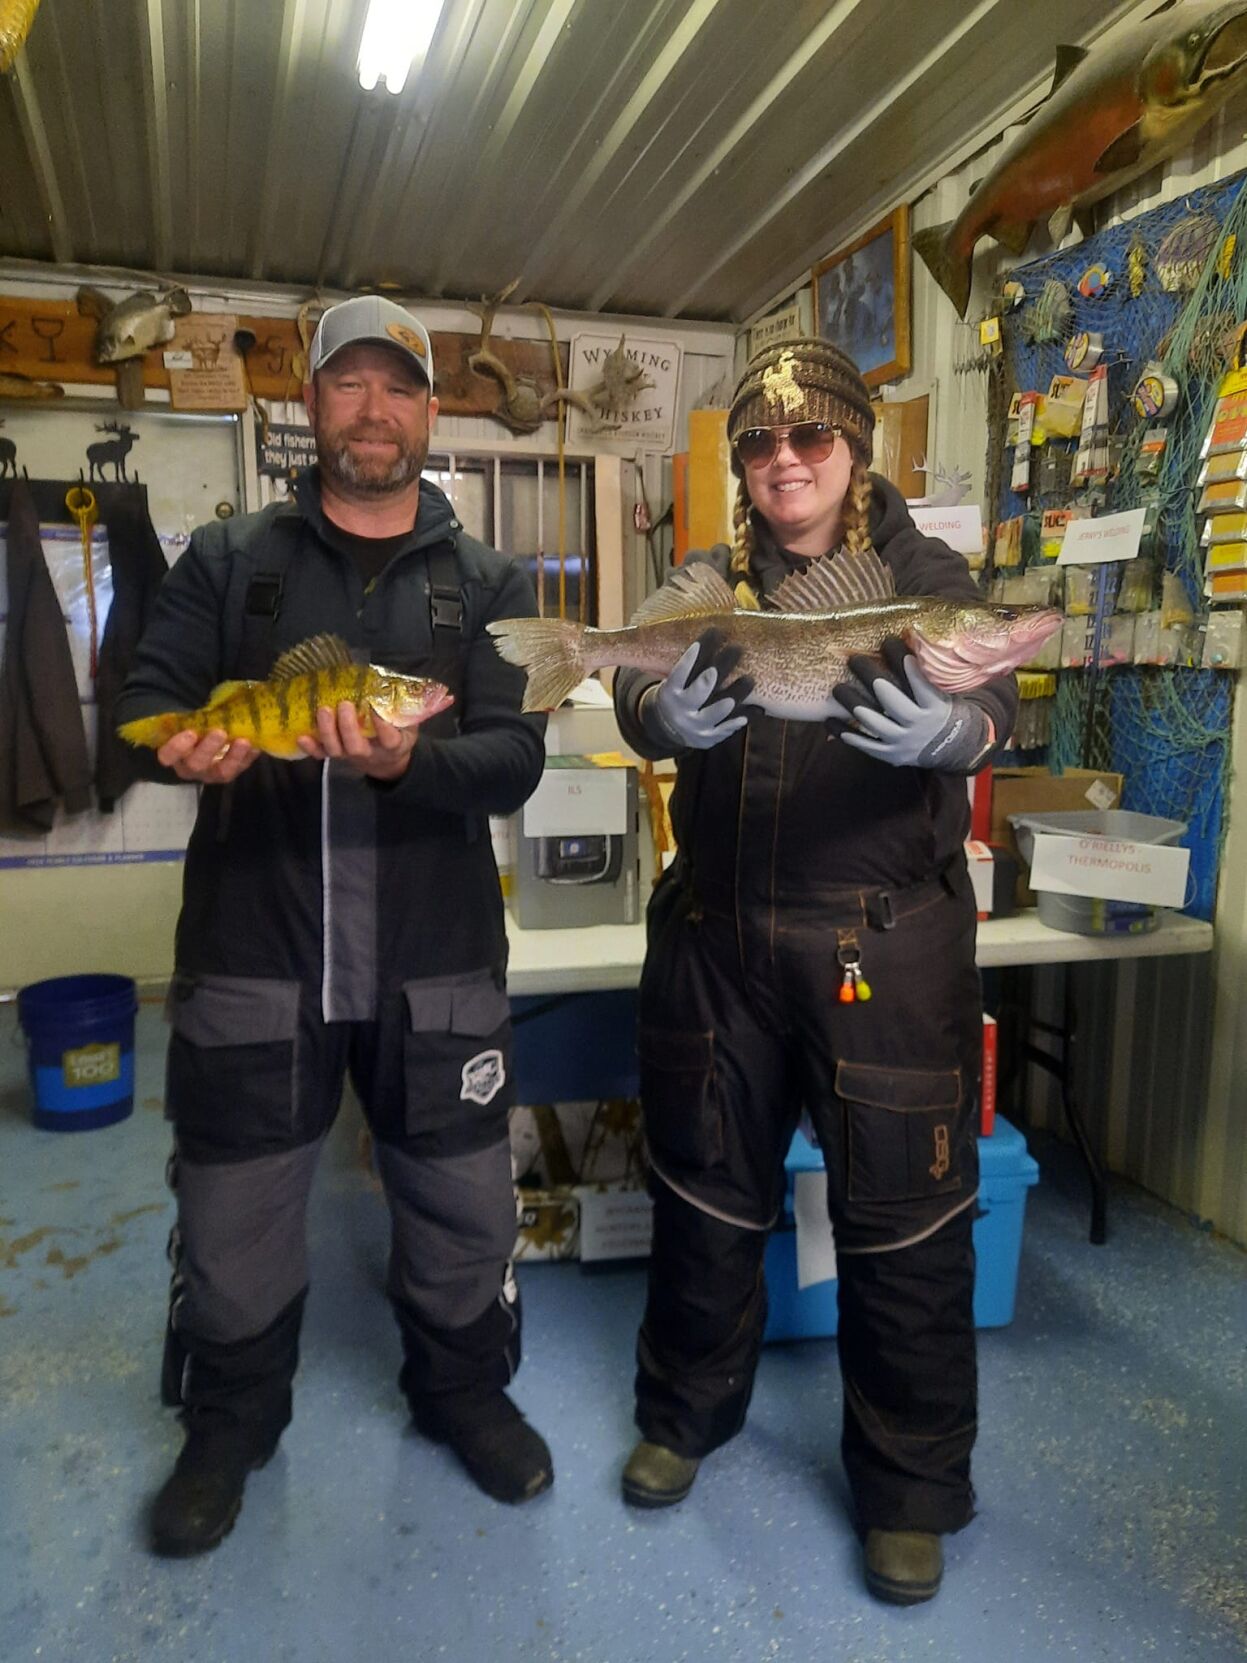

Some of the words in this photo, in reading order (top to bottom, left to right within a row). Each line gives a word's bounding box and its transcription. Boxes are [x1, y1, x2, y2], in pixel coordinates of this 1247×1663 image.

[582, 347, 671, 372] WYMING
[594, 406, 662, 422] HISKEY
[918, 520, 962, 531] WELDING
[1067, 856, 1152, 873] THERMOPOLIS
